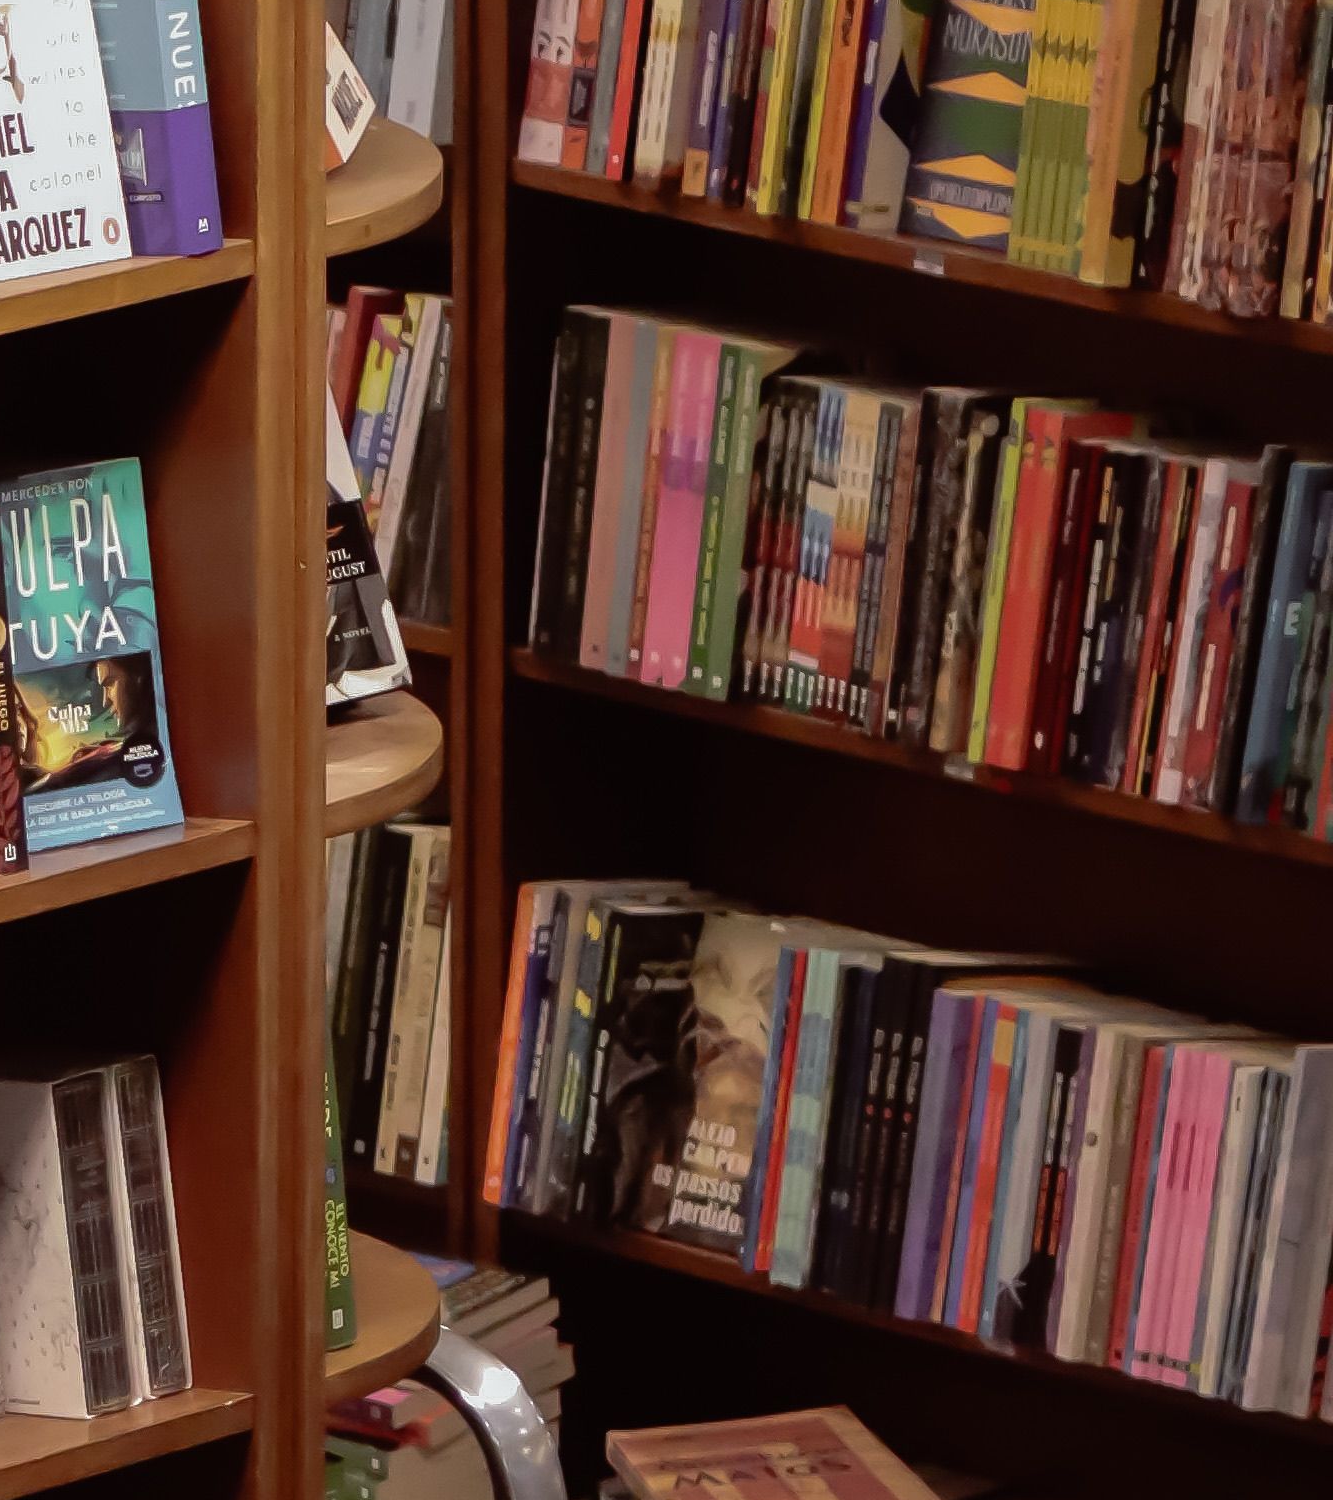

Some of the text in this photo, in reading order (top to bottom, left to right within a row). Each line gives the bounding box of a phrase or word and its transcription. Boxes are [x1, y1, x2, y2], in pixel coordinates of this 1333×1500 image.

[10, 493, 128, 597] ULPA
[325, 560, 366, 582] UGUST
[9, 605, 127, 666] TUYA
